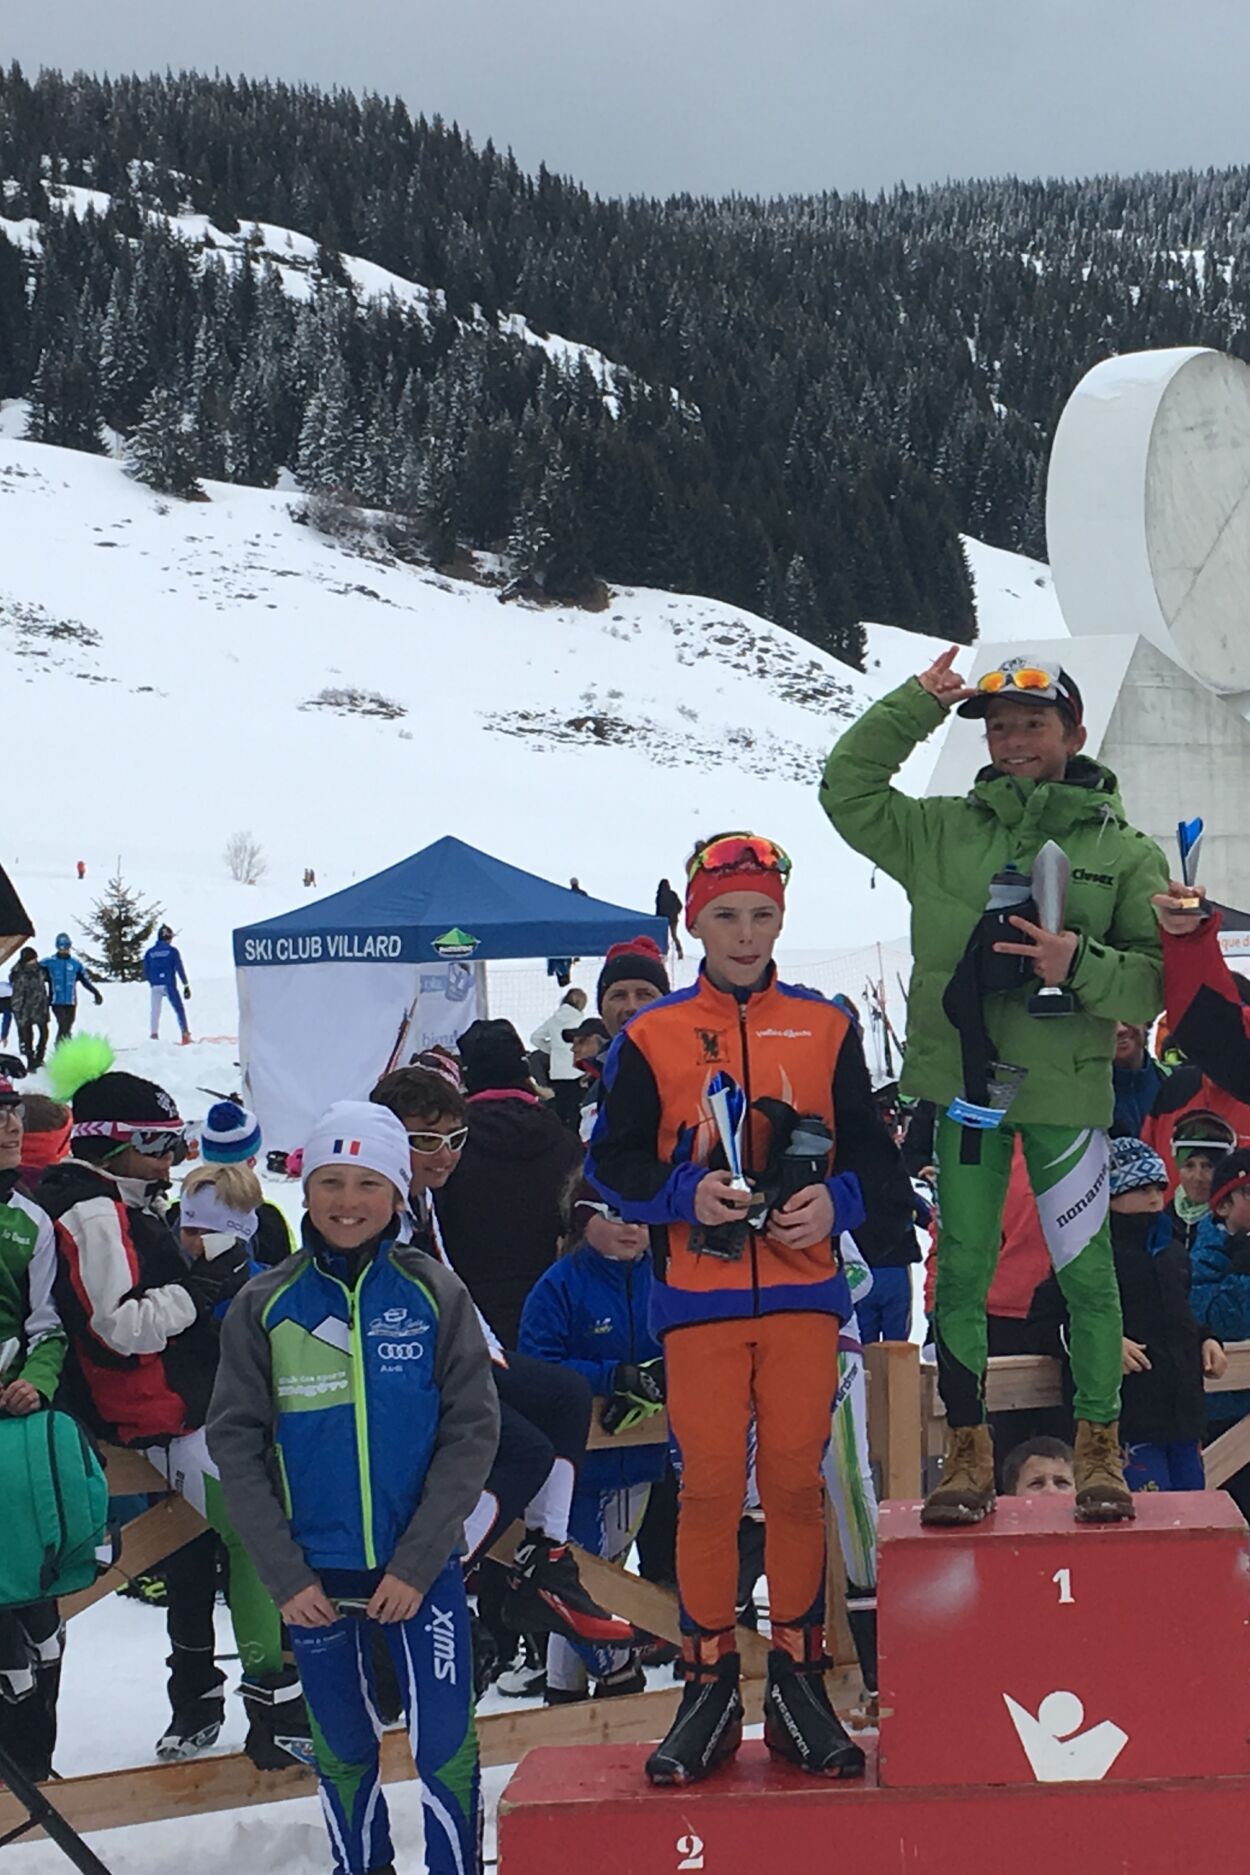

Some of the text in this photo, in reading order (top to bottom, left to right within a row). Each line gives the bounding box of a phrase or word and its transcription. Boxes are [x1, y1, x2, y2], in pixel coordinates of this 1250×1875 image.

[245, 935, 402, 961] SKI CLUB VILLARD
[1052, 1568, 1075, 1604] 1
[676, 1834, 704, 1870] 2
